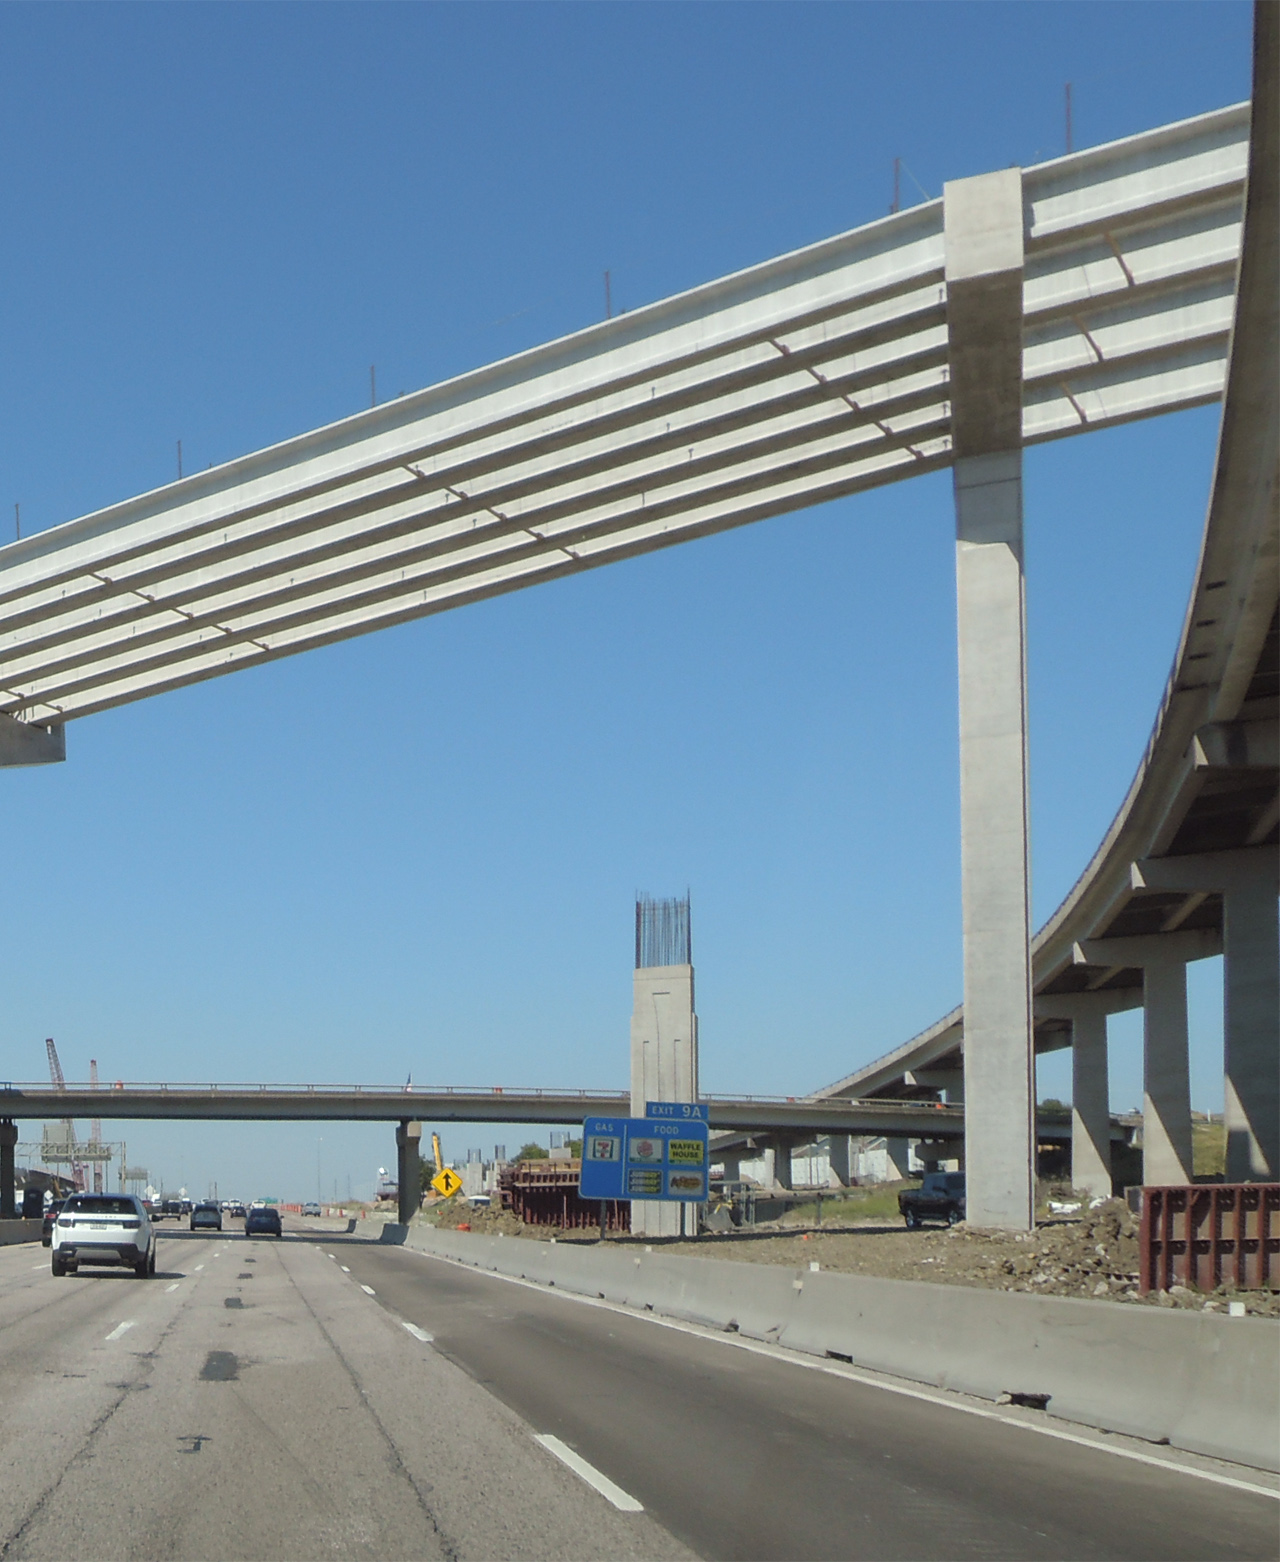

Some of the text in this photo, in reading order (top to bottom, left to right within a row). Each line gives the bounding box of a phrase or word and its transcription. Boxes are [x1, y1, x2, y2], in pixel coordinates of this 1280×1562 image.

[652, 1105, 702, 1118] EXIT 9A
[595, 1122, 614, 1132] GAS
[654, 1125, 679, 1134] FOOD
[670, 1142, 701, 1150] WAFFLE
